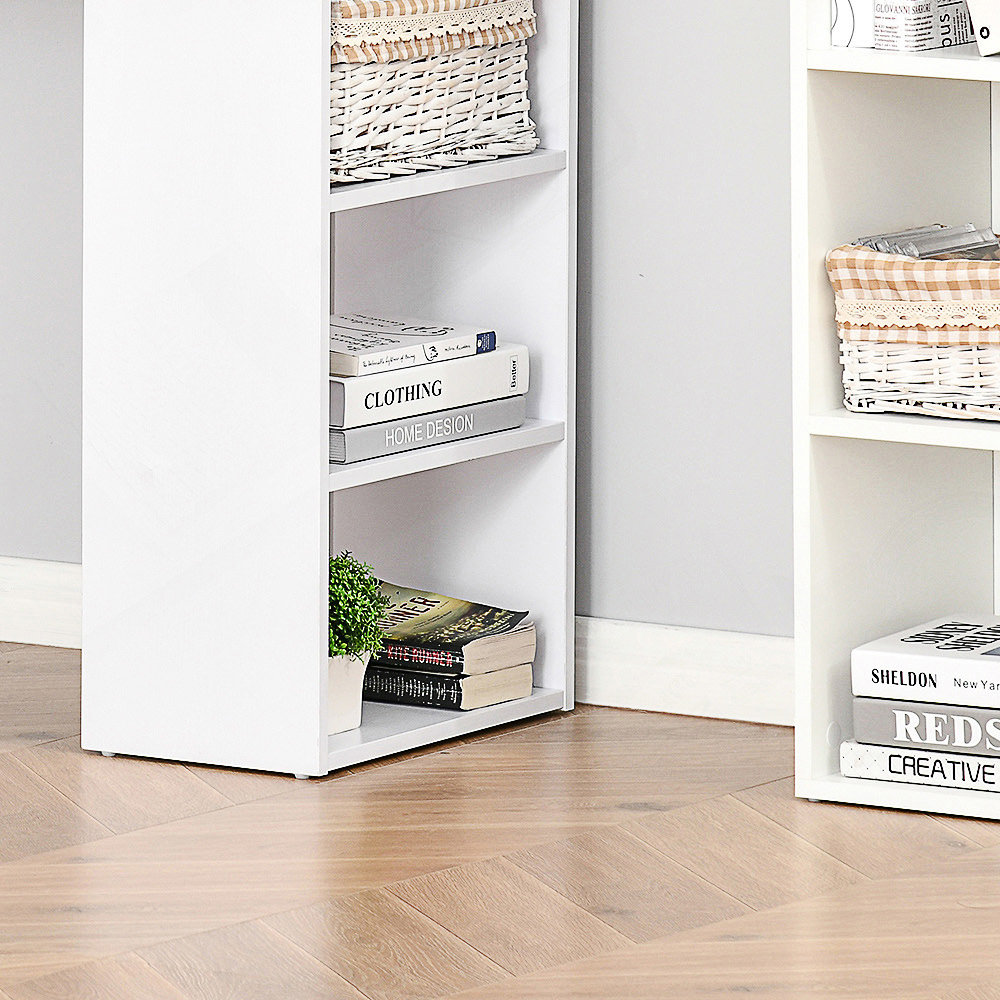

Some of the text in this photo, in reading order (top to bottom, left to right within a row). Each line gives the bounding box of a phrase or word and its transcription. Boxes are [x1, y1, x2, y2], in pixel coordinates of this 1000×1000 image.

[364, 380, 443, 410] CLOTHING
[385, 423, 423, 447] HOME
[871, 668, 938, 689] SHELDON
[953, 678, 978, 688] New
[888, 754, 996, 785] CREATIVE
